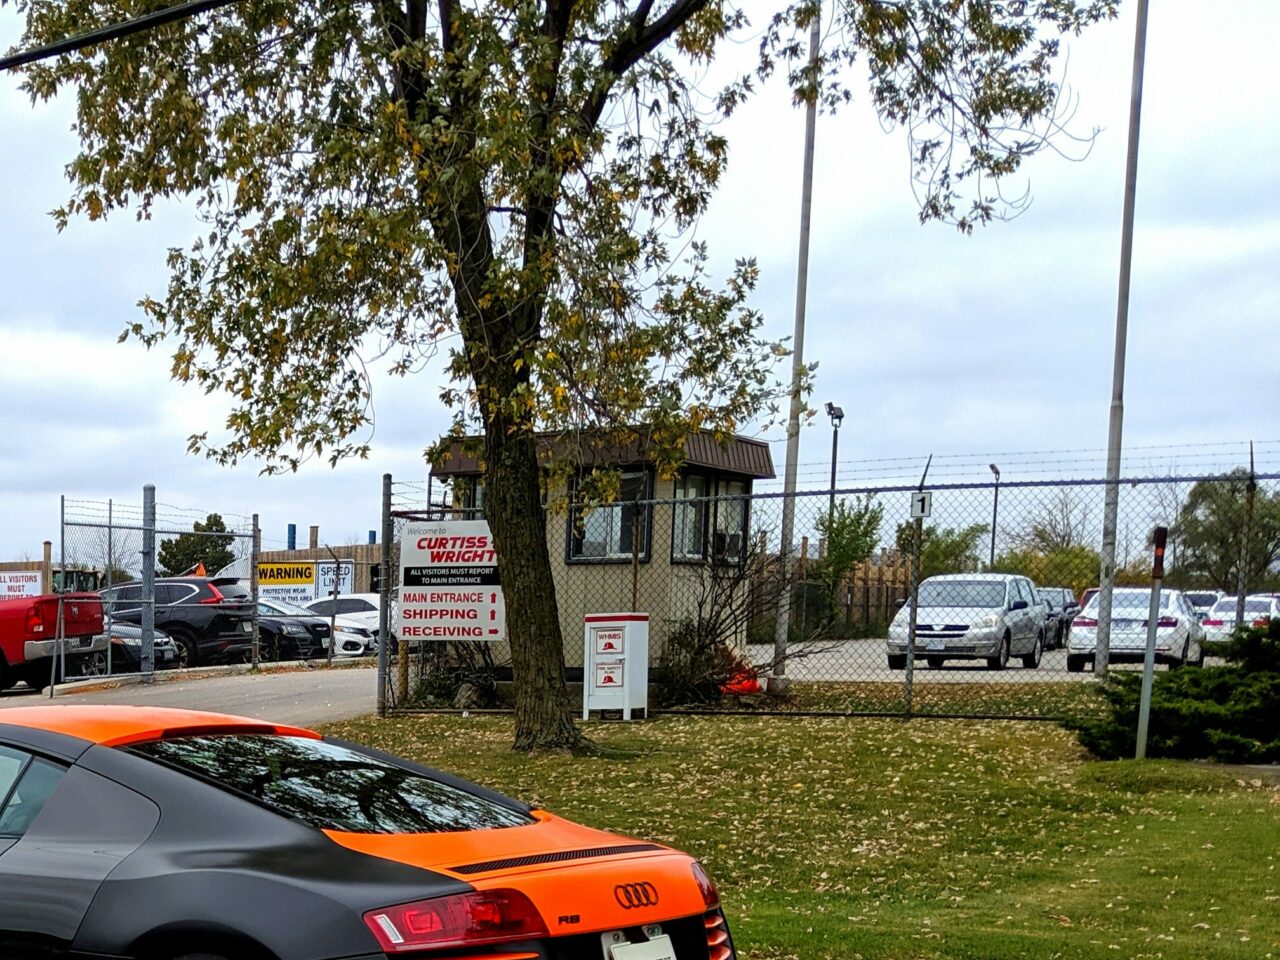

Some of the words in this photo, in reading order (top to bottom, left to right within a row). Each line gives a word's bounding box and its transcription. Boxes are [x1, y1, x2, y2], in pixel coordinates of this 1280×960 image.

[917, 496, 926, 514] 1
[417, 536, 488, 549] CURTISS
[431, 550, 496, 563] WRIGHT
[259, 567, 312, 579] WARNING
[321, 567, 350, 576] SPEED
[404, 593, 427, 602] MAIN
[430, 593, 484, 602] ENTRANCE
[403, 610, 478, 619] SHIPPING
[402, 627, 482, 636] RECEIVING
